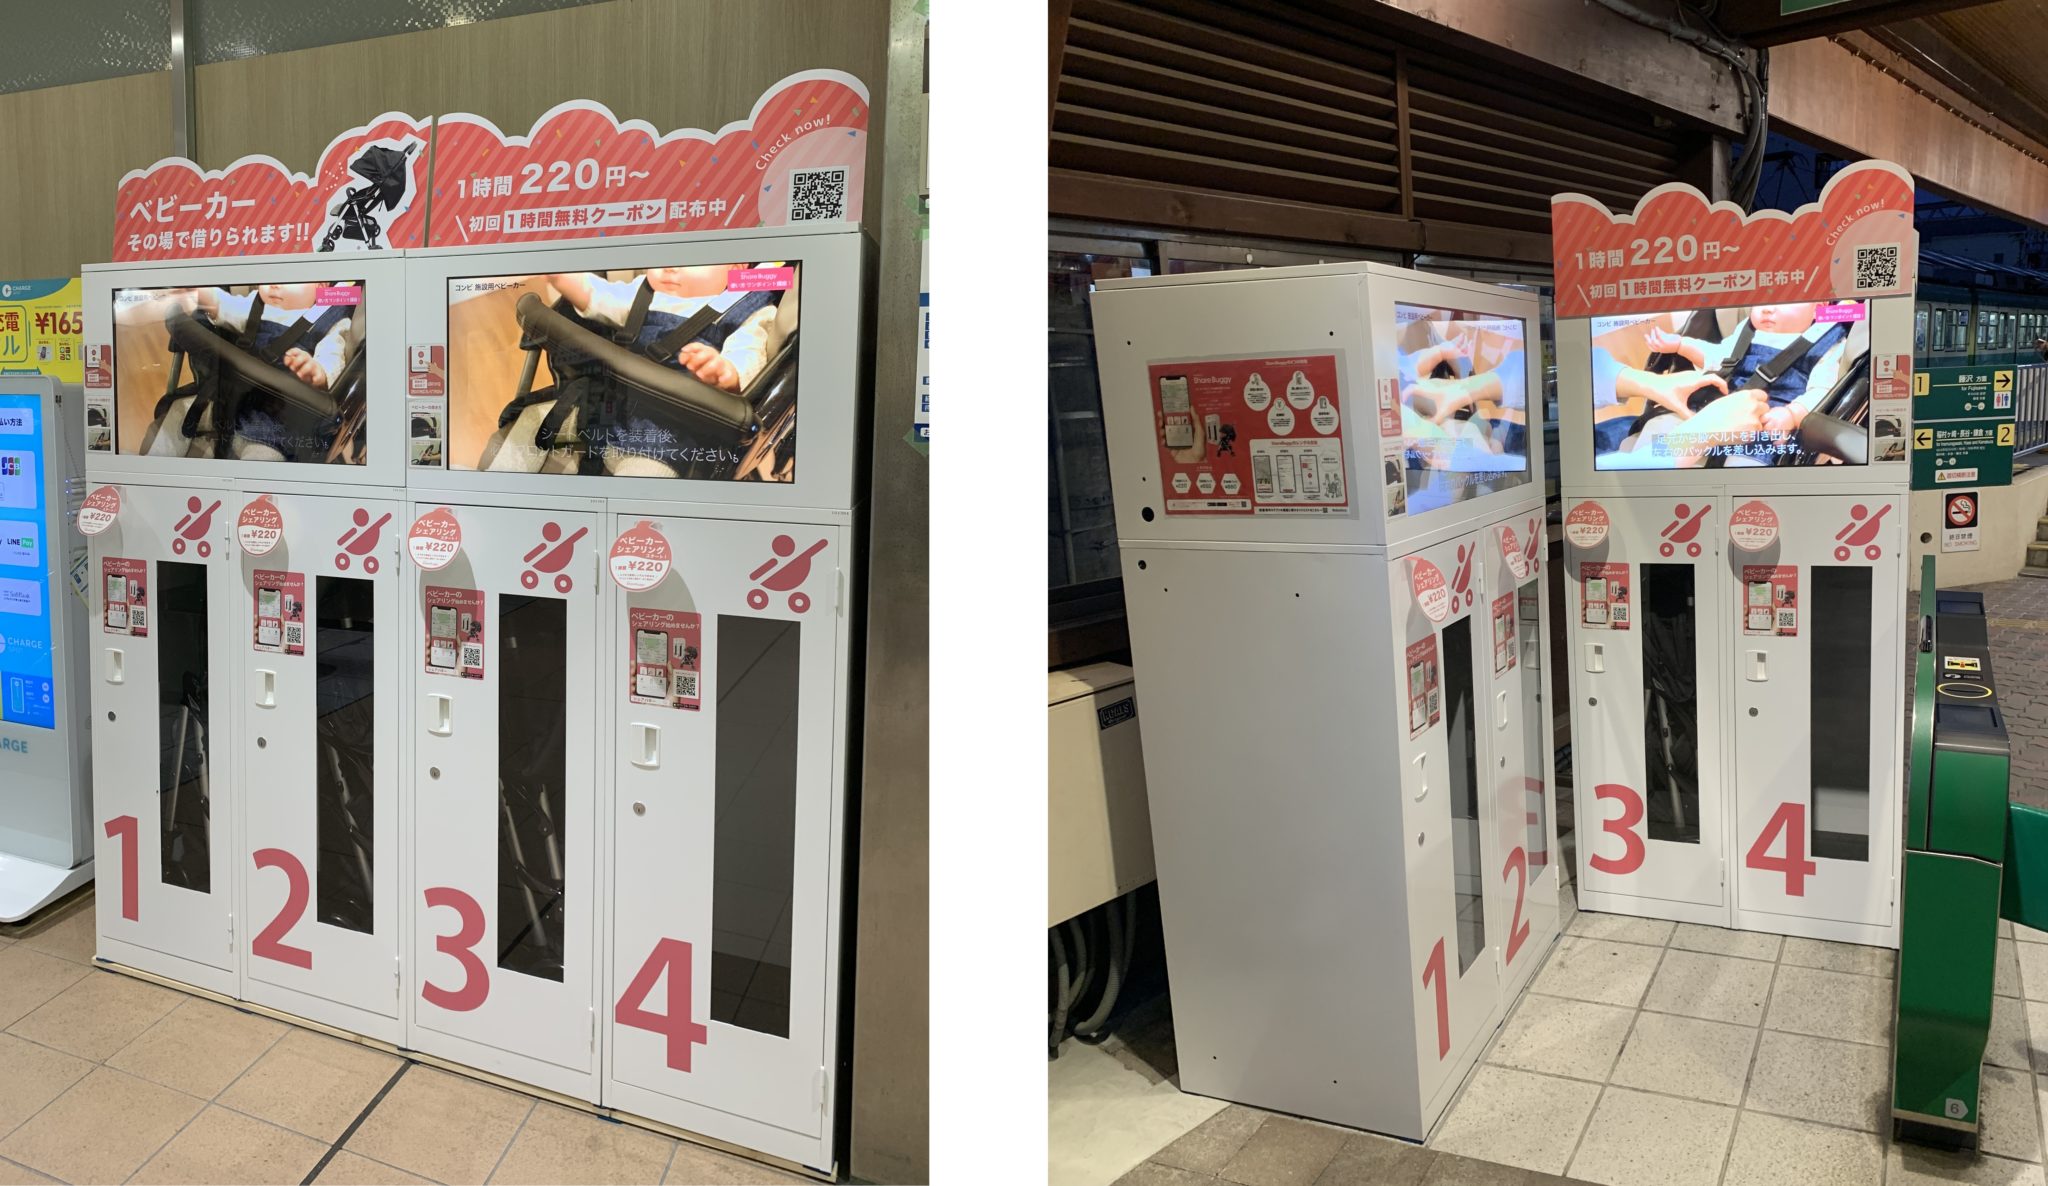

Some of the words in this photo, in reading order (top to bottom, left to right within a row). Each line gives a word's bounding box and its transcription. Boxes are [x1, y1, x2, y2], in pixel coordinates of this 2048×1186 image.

[755, 132, 792, 170] Check
[794, 114, 831, 136] now!
[130, 191, 256, 223] ベビーカー
[1826, 210, 1855, 247] Check
[1855, 198, 1885, 217] now!
[0, 312, 19, 332] 電
[1917, 377, 1923, 392] 1
[2001, 426, 2010, 443] 2
[243, 508, 276, 516] ベビーカー
[242, 516, 278, 524] シェアリング
[418, 519, 456, 529] ベビーカー
[251, 529, 277, 539] ¥220
[415, 527, 457, 536] シェアリング
[1745, 527, 1773, 537] ¥220
[7, 538, 20, 546] LINE
[425, 542, 454, 552] ¥220
[619, 537, 664, 545] ベビーカー
[617, 545, 665, 555] シェアリング
[628, 560, 663, 572] ¥220
[631, 612, 674, 621] ベビーカーの
[8, 637, 43, 649] CHARGE
[1589, 783, 1646, 876] 3
[1745, 801, 1817, 897] 4
[104, 814, 139, 923] 1
[252, 847, 313, 971] 2
[1502, 846, 1530, 967] 2
[421, 886, 491, 1012] 3
[614, 936, 708, 1074] 4
[1421, 936, 1451, 1062] 1
[1950, 1103, 1959, 1114] 6
